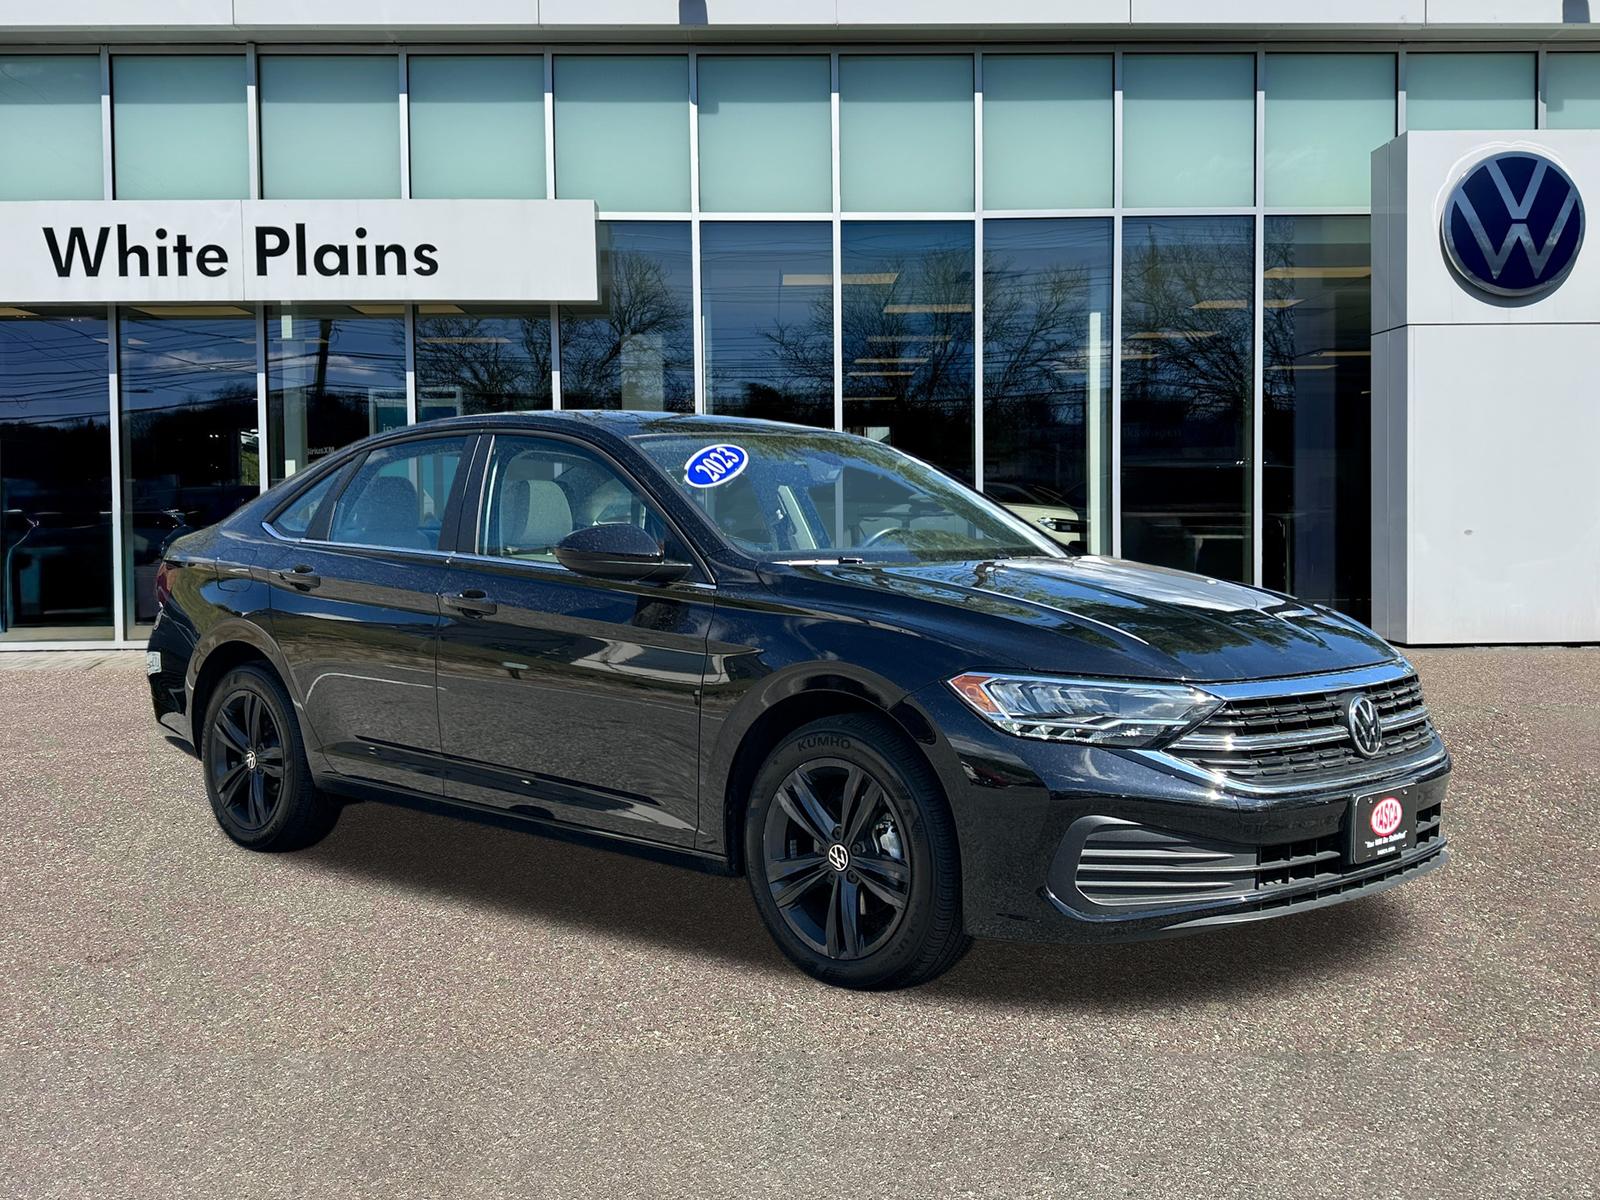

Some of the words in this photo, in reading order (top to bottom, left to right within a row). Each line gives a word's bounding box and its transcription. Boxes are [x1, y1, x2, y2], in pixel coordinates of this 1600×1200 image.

[43, 224, 228, 277] White
[256, 223, 438, 277] Plains
[695, 447, 739, 482] 2023
[797, 735, 851, 751] KUMHO
[1375, 802, 1398, 829] TASCA
